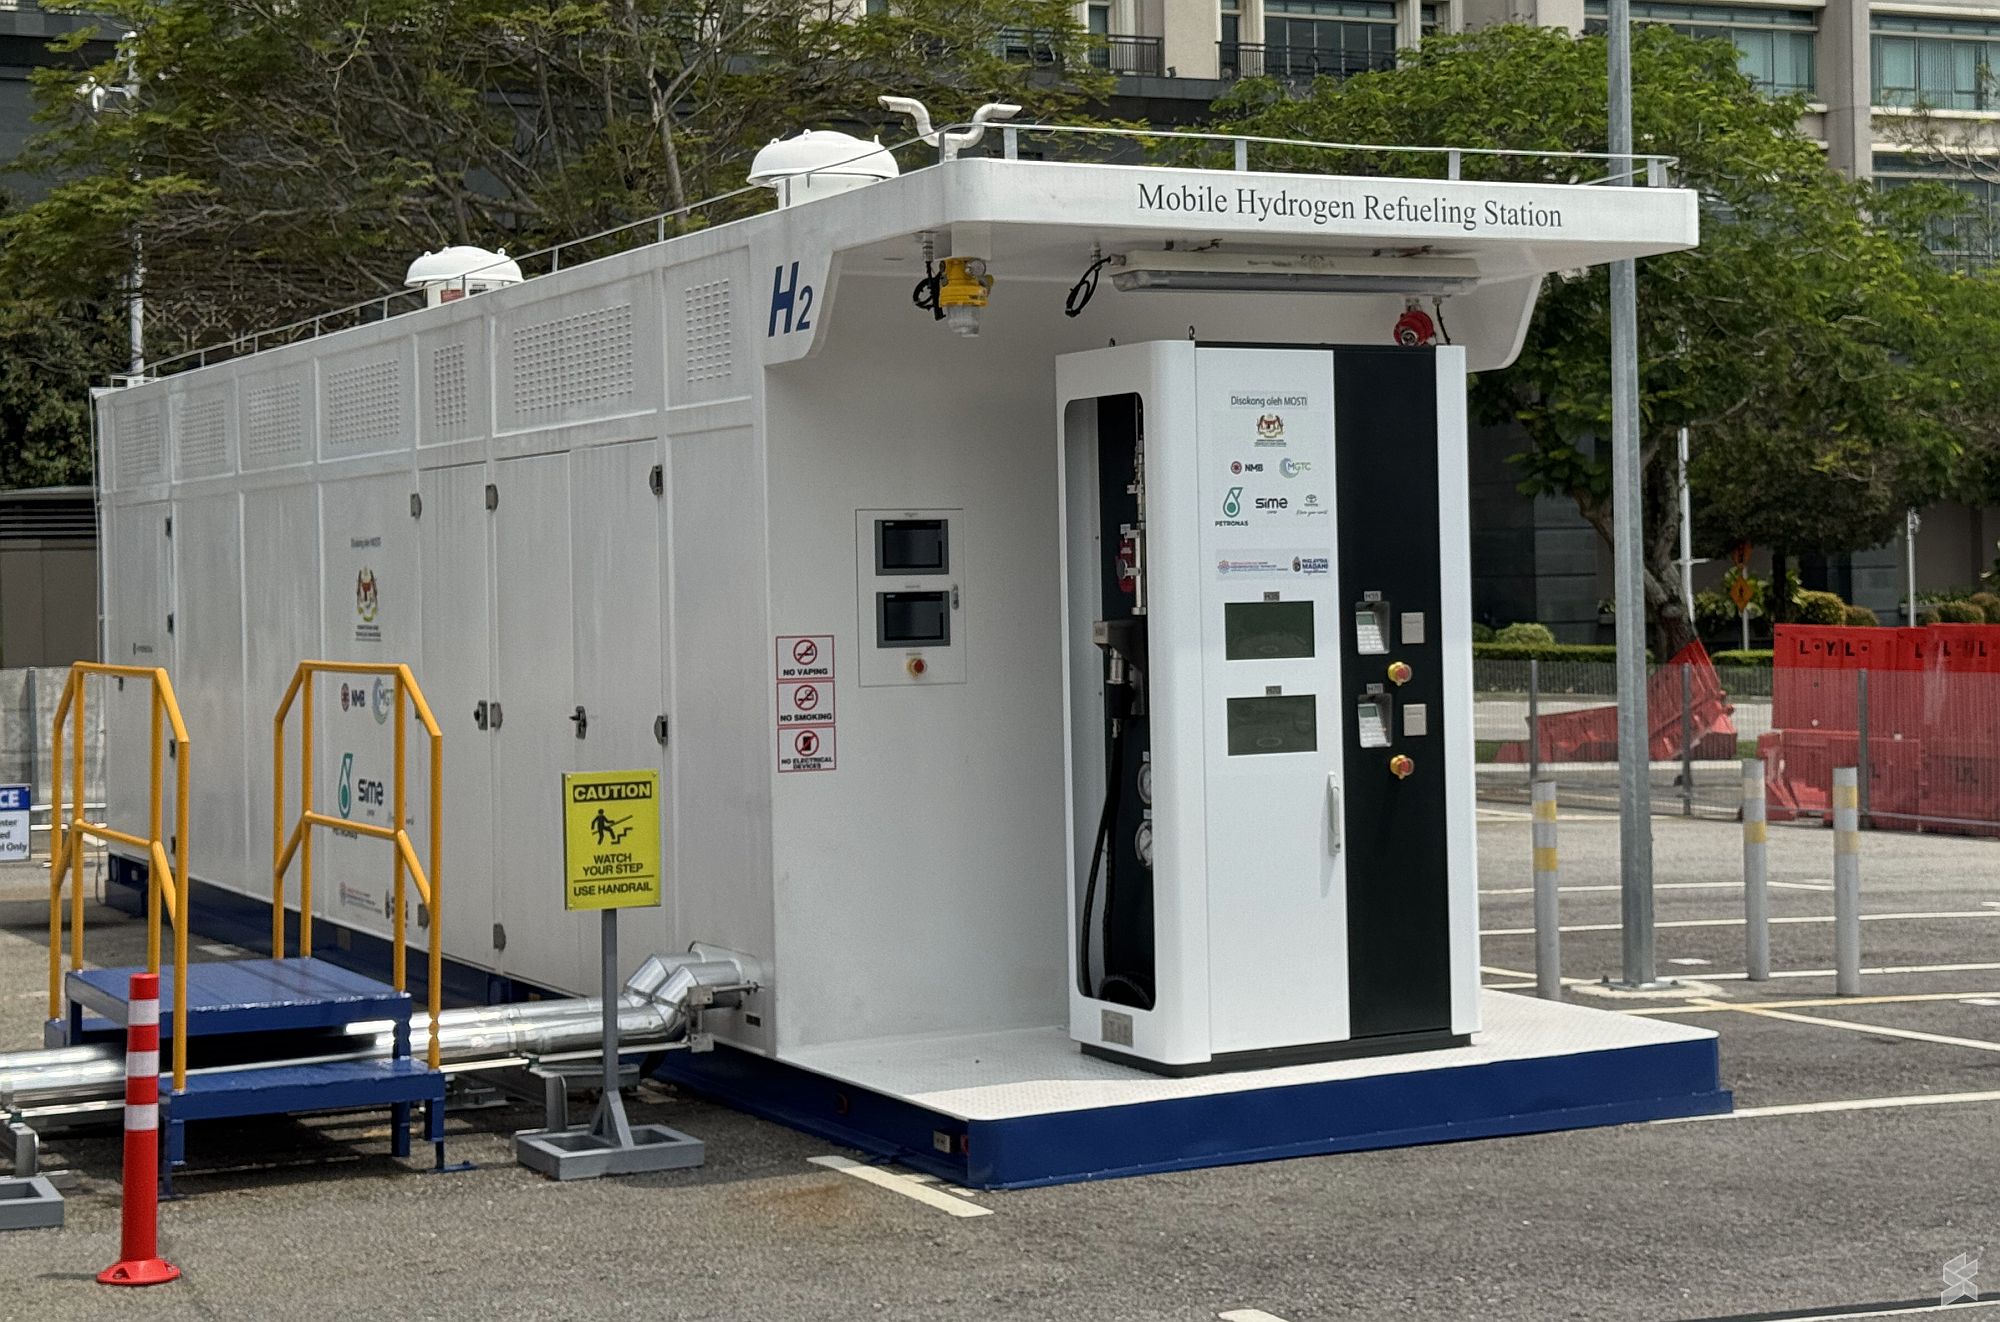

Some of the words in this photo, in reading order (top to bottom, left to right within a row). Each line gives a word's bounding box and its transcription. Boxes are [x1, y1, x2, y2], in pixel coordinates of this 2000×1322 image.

[1137, 182, 1228, 213] Mobile
[1236, 188, 1355, 226] Hydrogen
[1363, 195, 1477, 231] Refueling
[1484, 200, 1562, 228] Station
[768, 261, 813, 338] H2
[1283, 397, 1308, 406] MOSTI
[1244, 463, 1264, 472] NMB
[783, 668, 795, 676] NO
[797, 667, 828, 676] VAPING
[780, 714, 792, 722] NO
[794, 712, 832, 722] SMOKING
[793, 756, 833, 764] ELECTRICAL
[574, 783, 651, 801] CAUTION
[593, 853, 632, 864] WATCH
[582, 864, 613, 876] YOUR
[616, 863, 643, 874] STEP
[573, 886, 596, 897] USE
[598, 882, 653, 895] HANDRAIL
